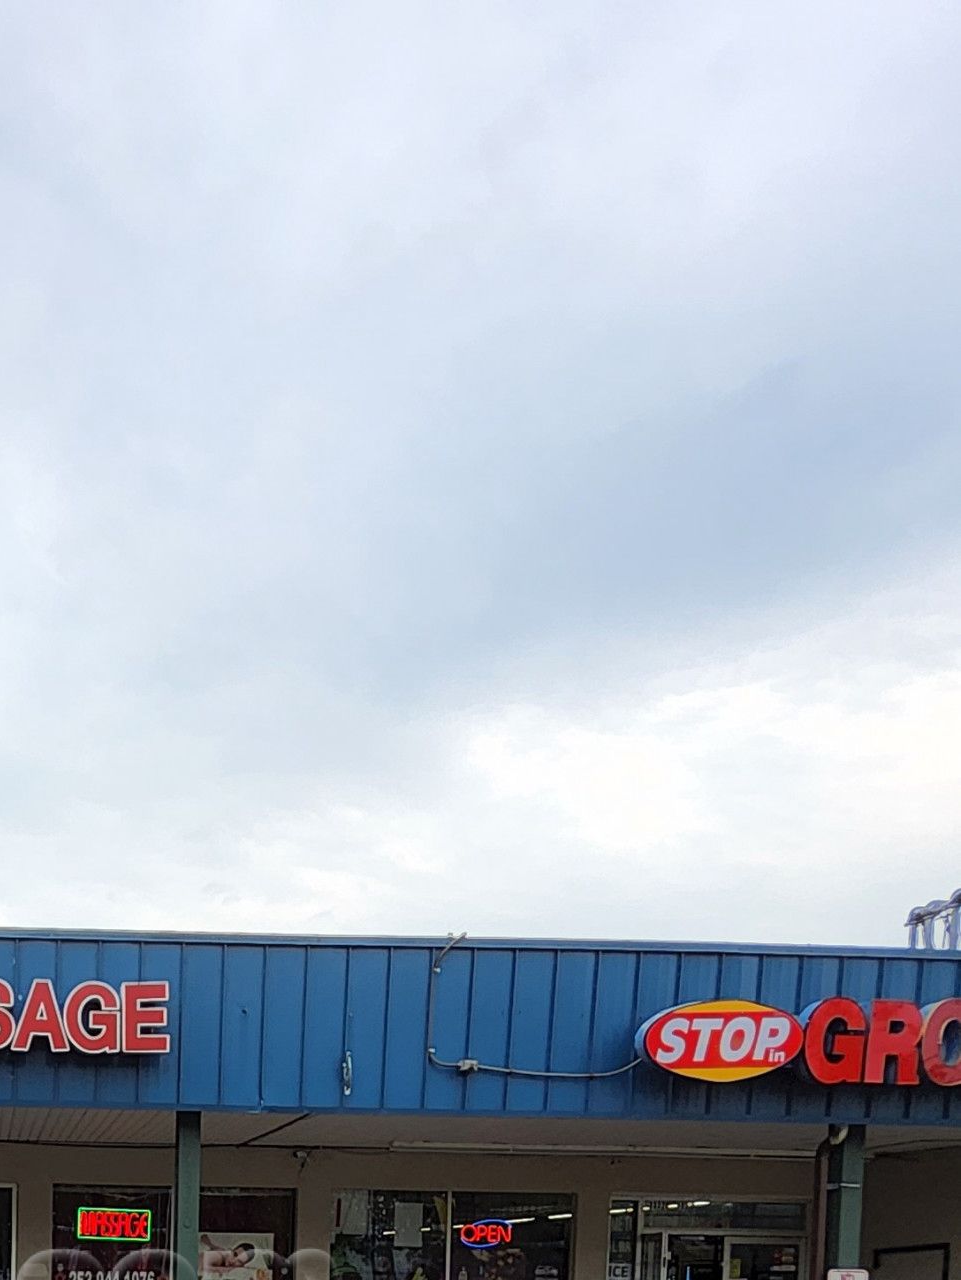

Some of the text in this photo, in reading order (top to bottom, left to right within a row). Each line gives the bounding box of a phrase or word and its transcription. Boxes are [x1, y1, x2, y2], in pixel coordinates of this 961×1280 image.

[656, 1016, 790, 1063] STOP in
[79, 1210, 148, 1238] MASSAGE
[460, 1224, 513, 1244] OPEN
